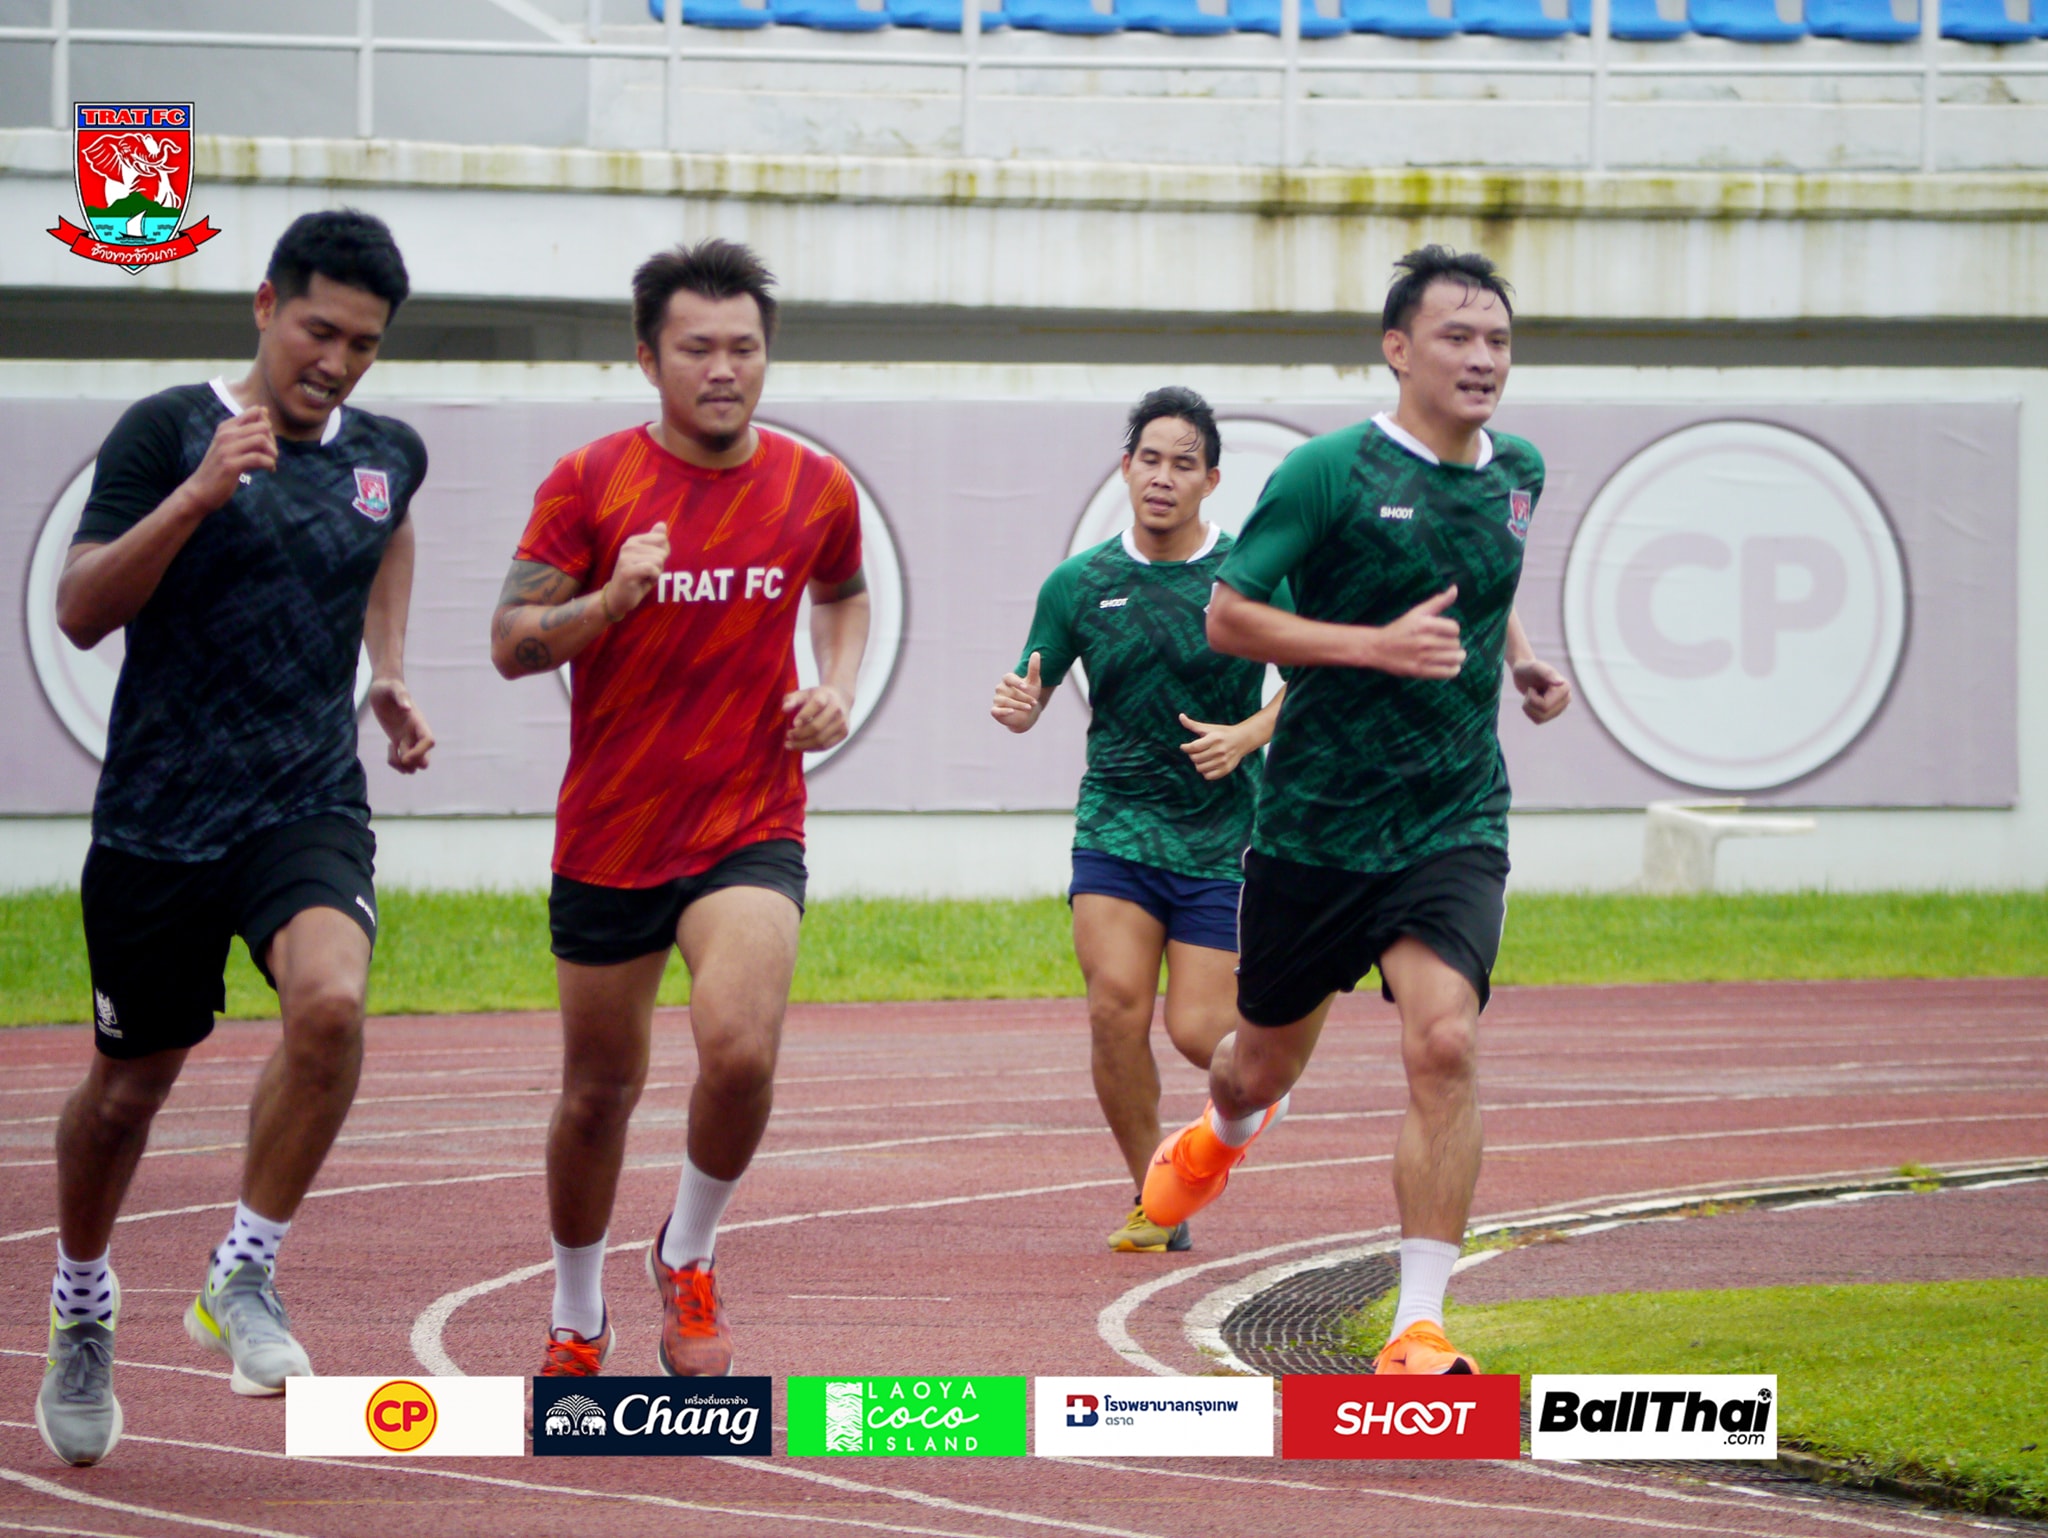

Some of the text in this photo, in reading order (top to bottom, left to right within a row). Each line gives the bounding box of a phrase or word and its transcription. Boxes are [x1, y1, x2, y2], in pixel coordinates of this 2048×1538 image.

[657, 567, 784, 603] TRAT FC
[1615, 531, 1848, 680] CP
